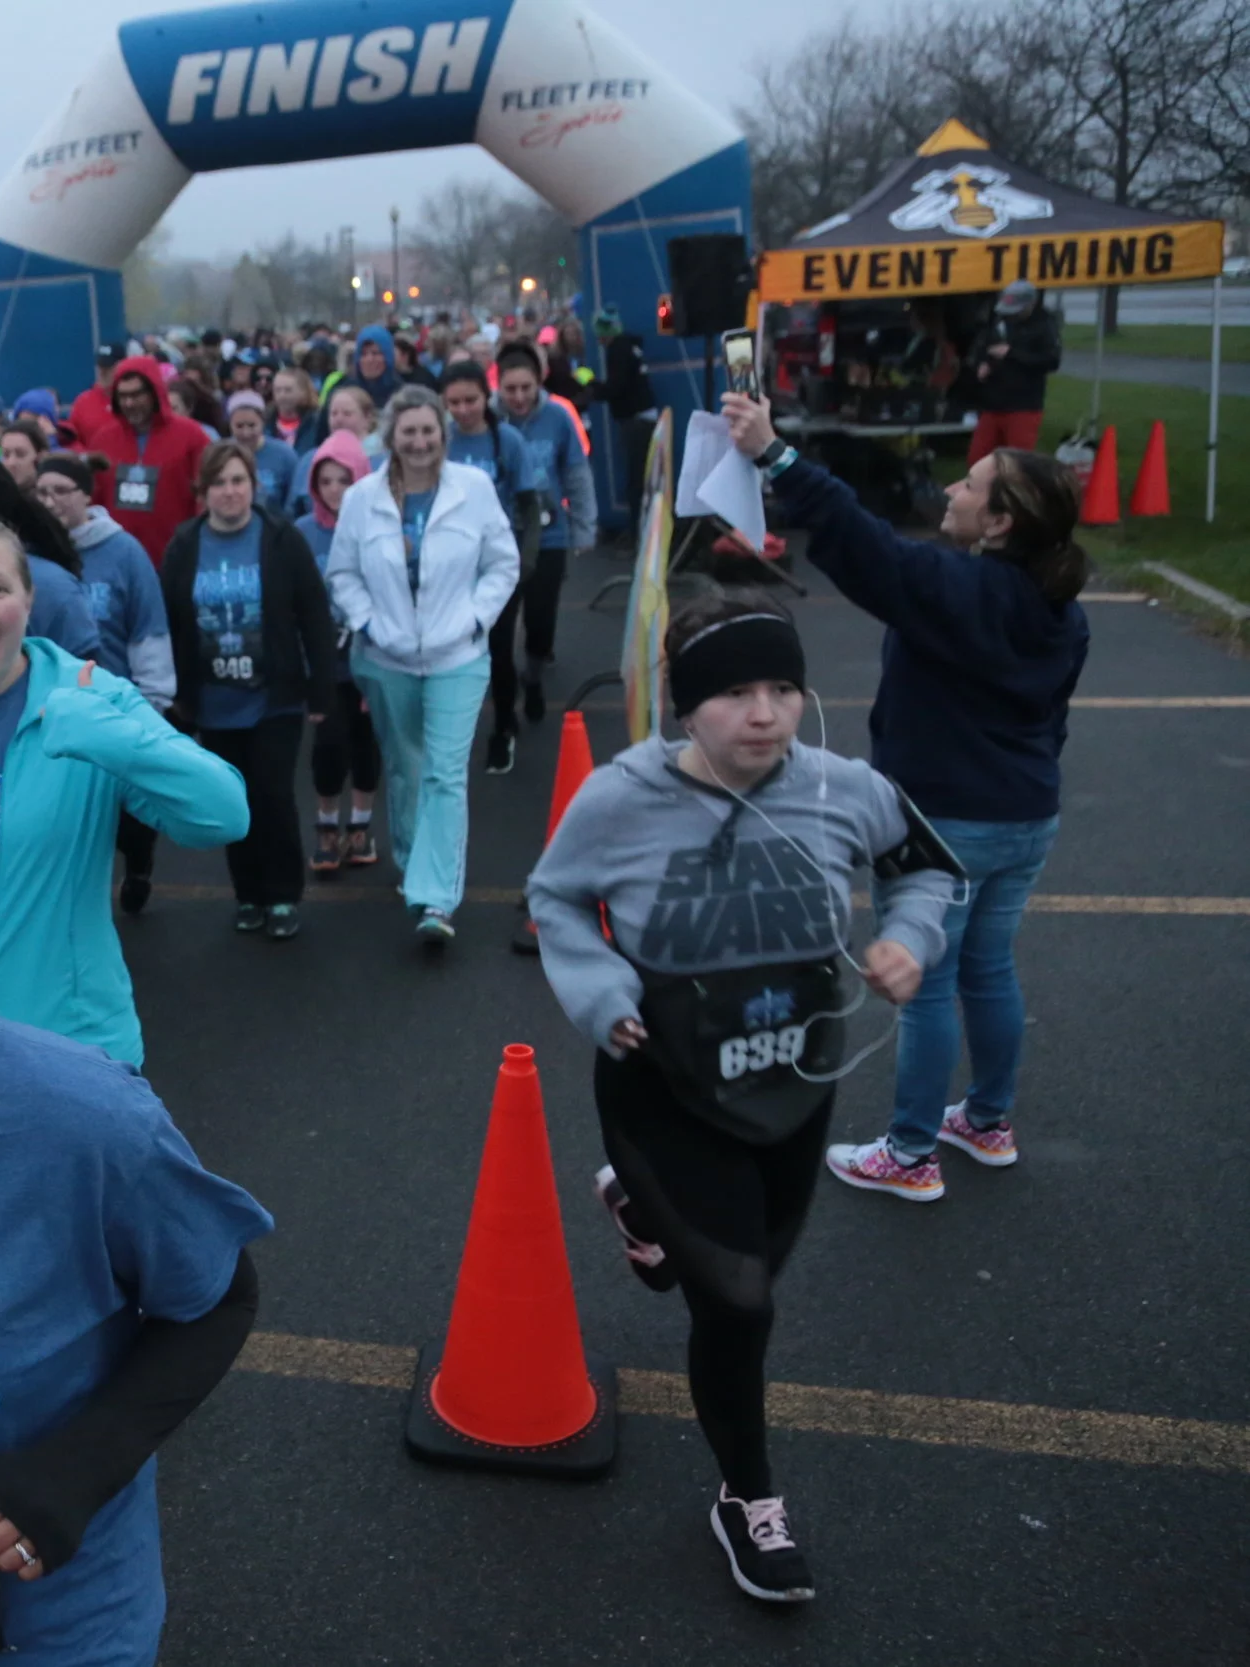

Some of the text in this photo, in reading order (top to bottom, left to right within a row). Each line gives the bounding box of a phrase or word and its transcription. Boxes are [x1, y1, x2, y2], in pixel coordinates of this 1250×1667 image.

[167, 17, 490, 125] FINISH
[501, 78, 650, 112] FLEET FEET
[83, 130, 144, 157] FEET
[802, 232, 1174, 292] EVENT TIMING
[657, 836, 827, 900] STAR
[639, 883, 848, 964] WARS
